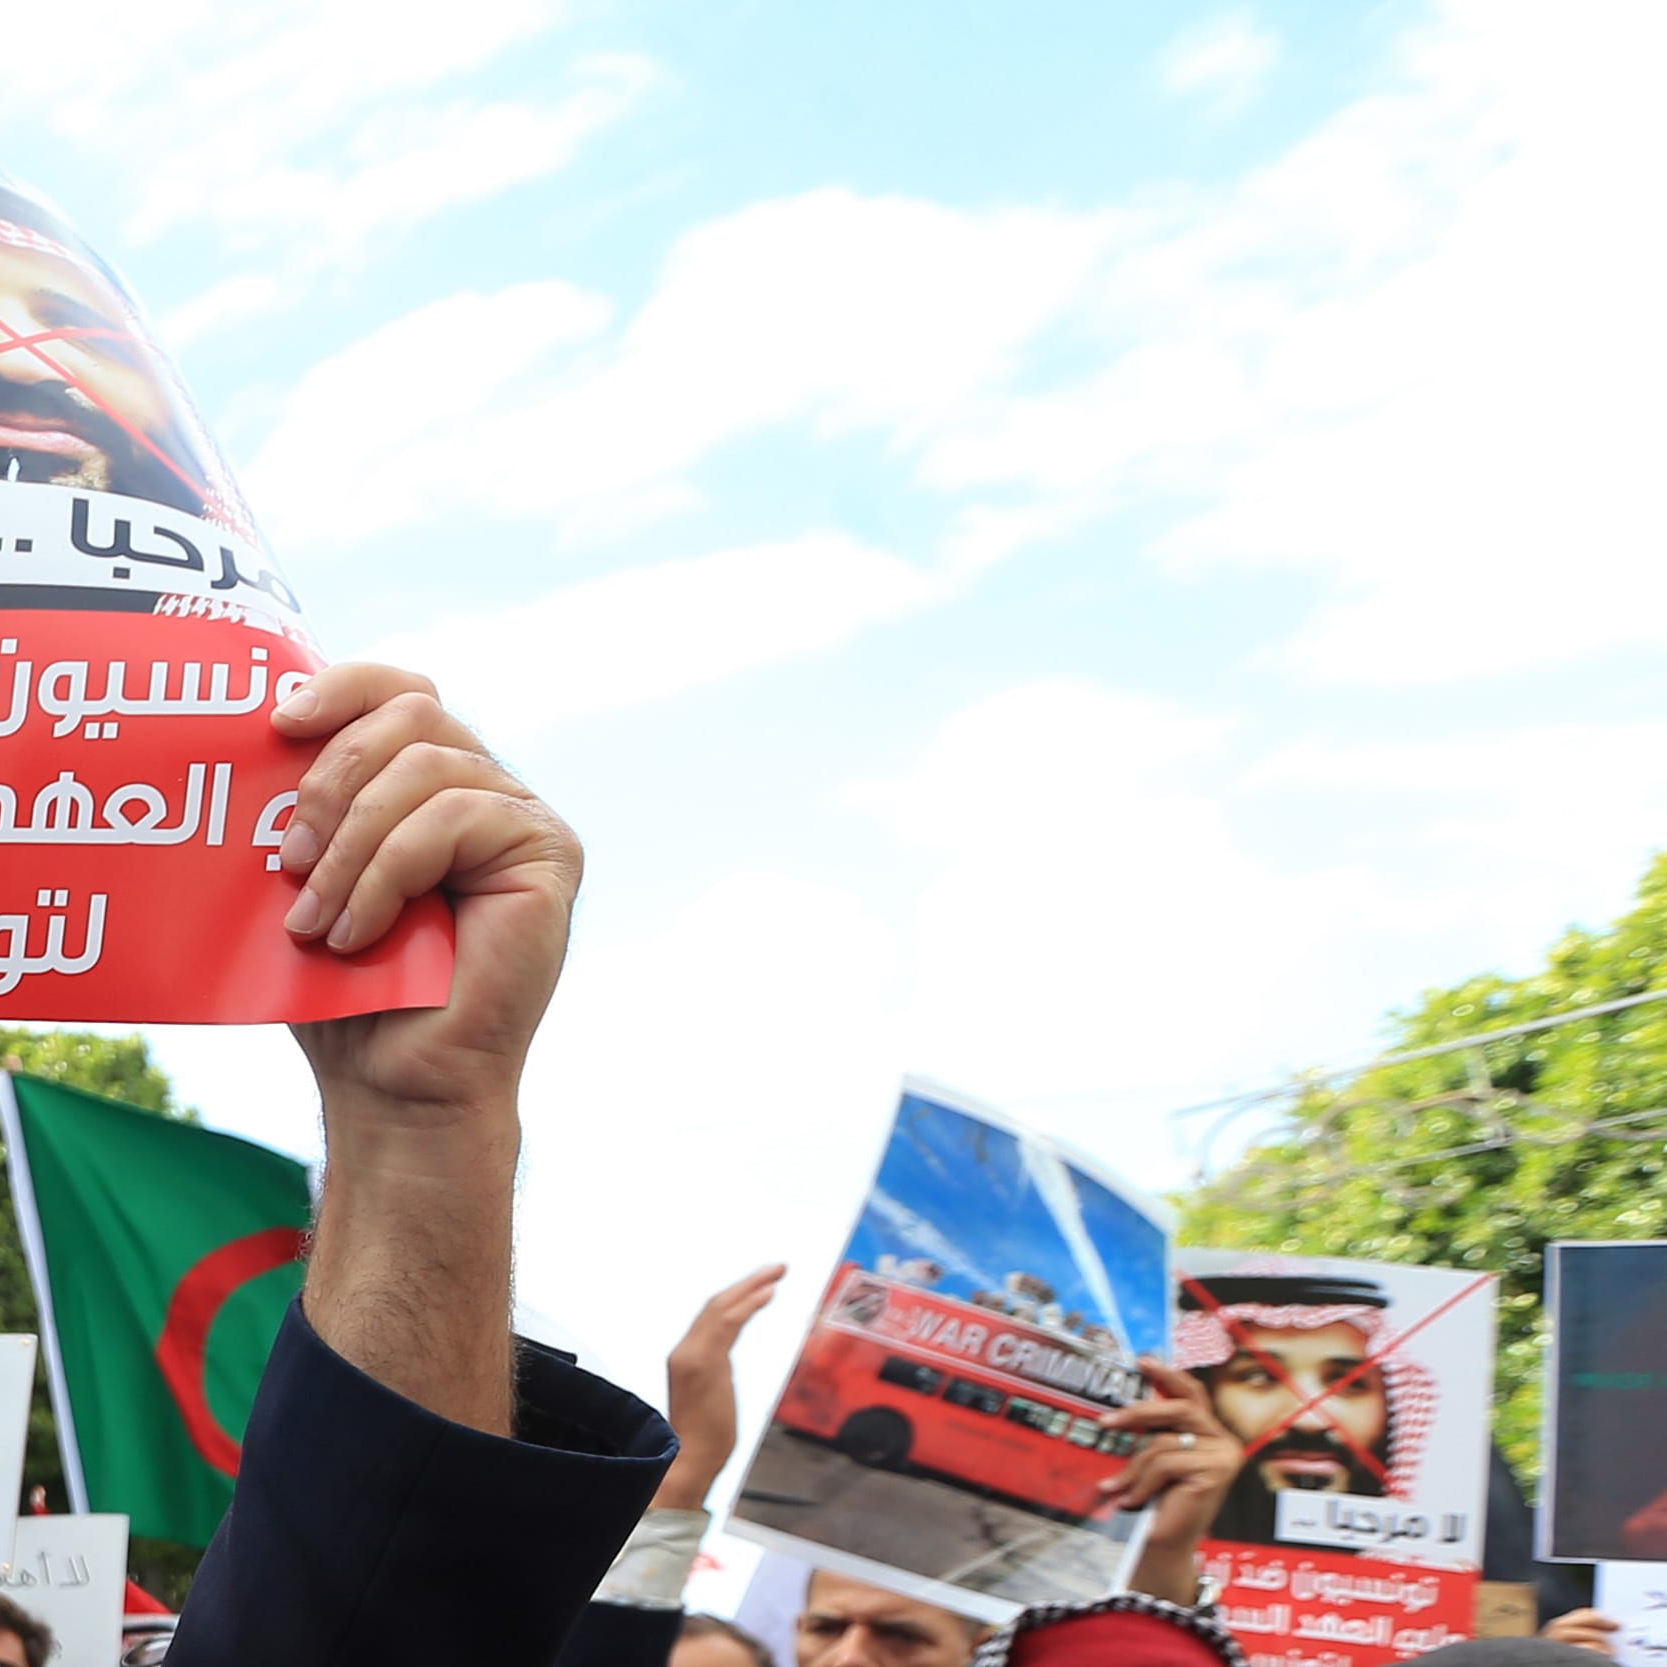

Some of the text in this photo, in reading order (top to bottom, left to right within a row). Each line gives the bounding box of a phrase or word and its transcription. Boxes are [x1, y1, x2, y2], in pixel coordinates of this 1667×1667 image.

[1327, 1500, 1430, 1544] مرحبا
[1439, 1513, 1467, 1544] لا
[1291, 1560, 1440, 1614] تونسيون
[1292, 1611, 1395, 1650] العهد
